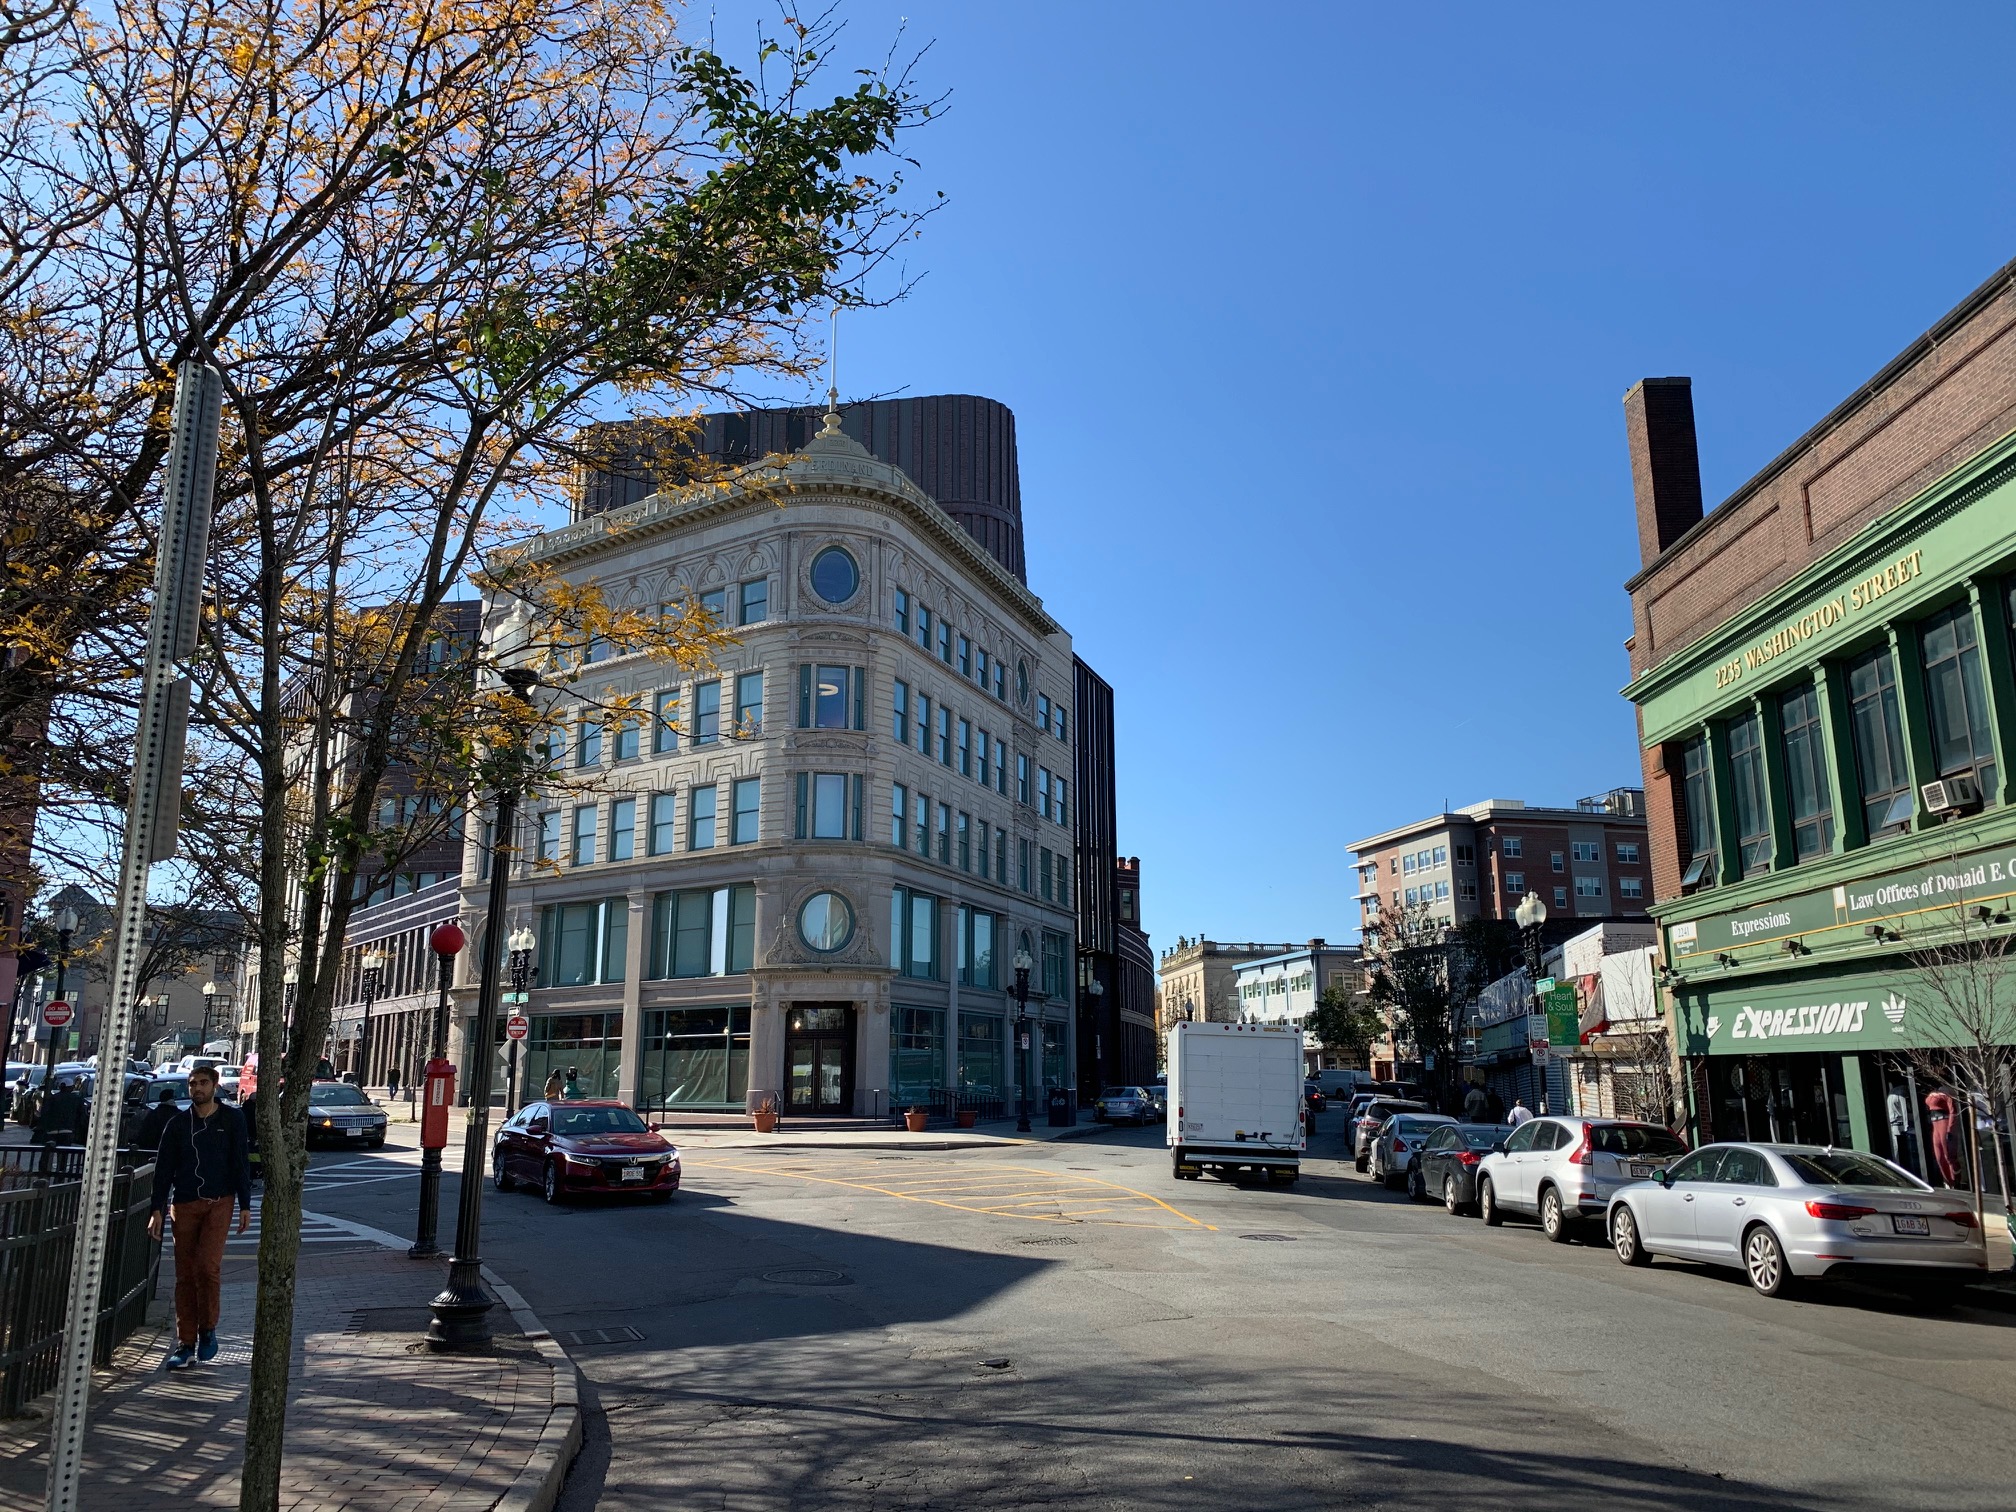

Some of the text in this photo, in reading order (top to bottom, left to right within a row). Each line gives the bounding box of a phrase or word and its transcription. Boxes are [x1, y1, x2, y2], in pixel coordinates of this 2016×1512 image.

[1715, 549, 1923, 689] 2235 WASHINGTON STREET
[1849, 893, 1874, 911] Law
[1876, 883, 1919, 905] Offices
[1921, 877, 1934, 896] of
[1936, 865, 1986, 893] Donald
[1989, 862, 2006, 882] E.
[1731, 911, 1791, 937] Expressions
[1548, 1002, 1574, 1011] & Soul
[1550, 991, 1573, 1001] Heart
